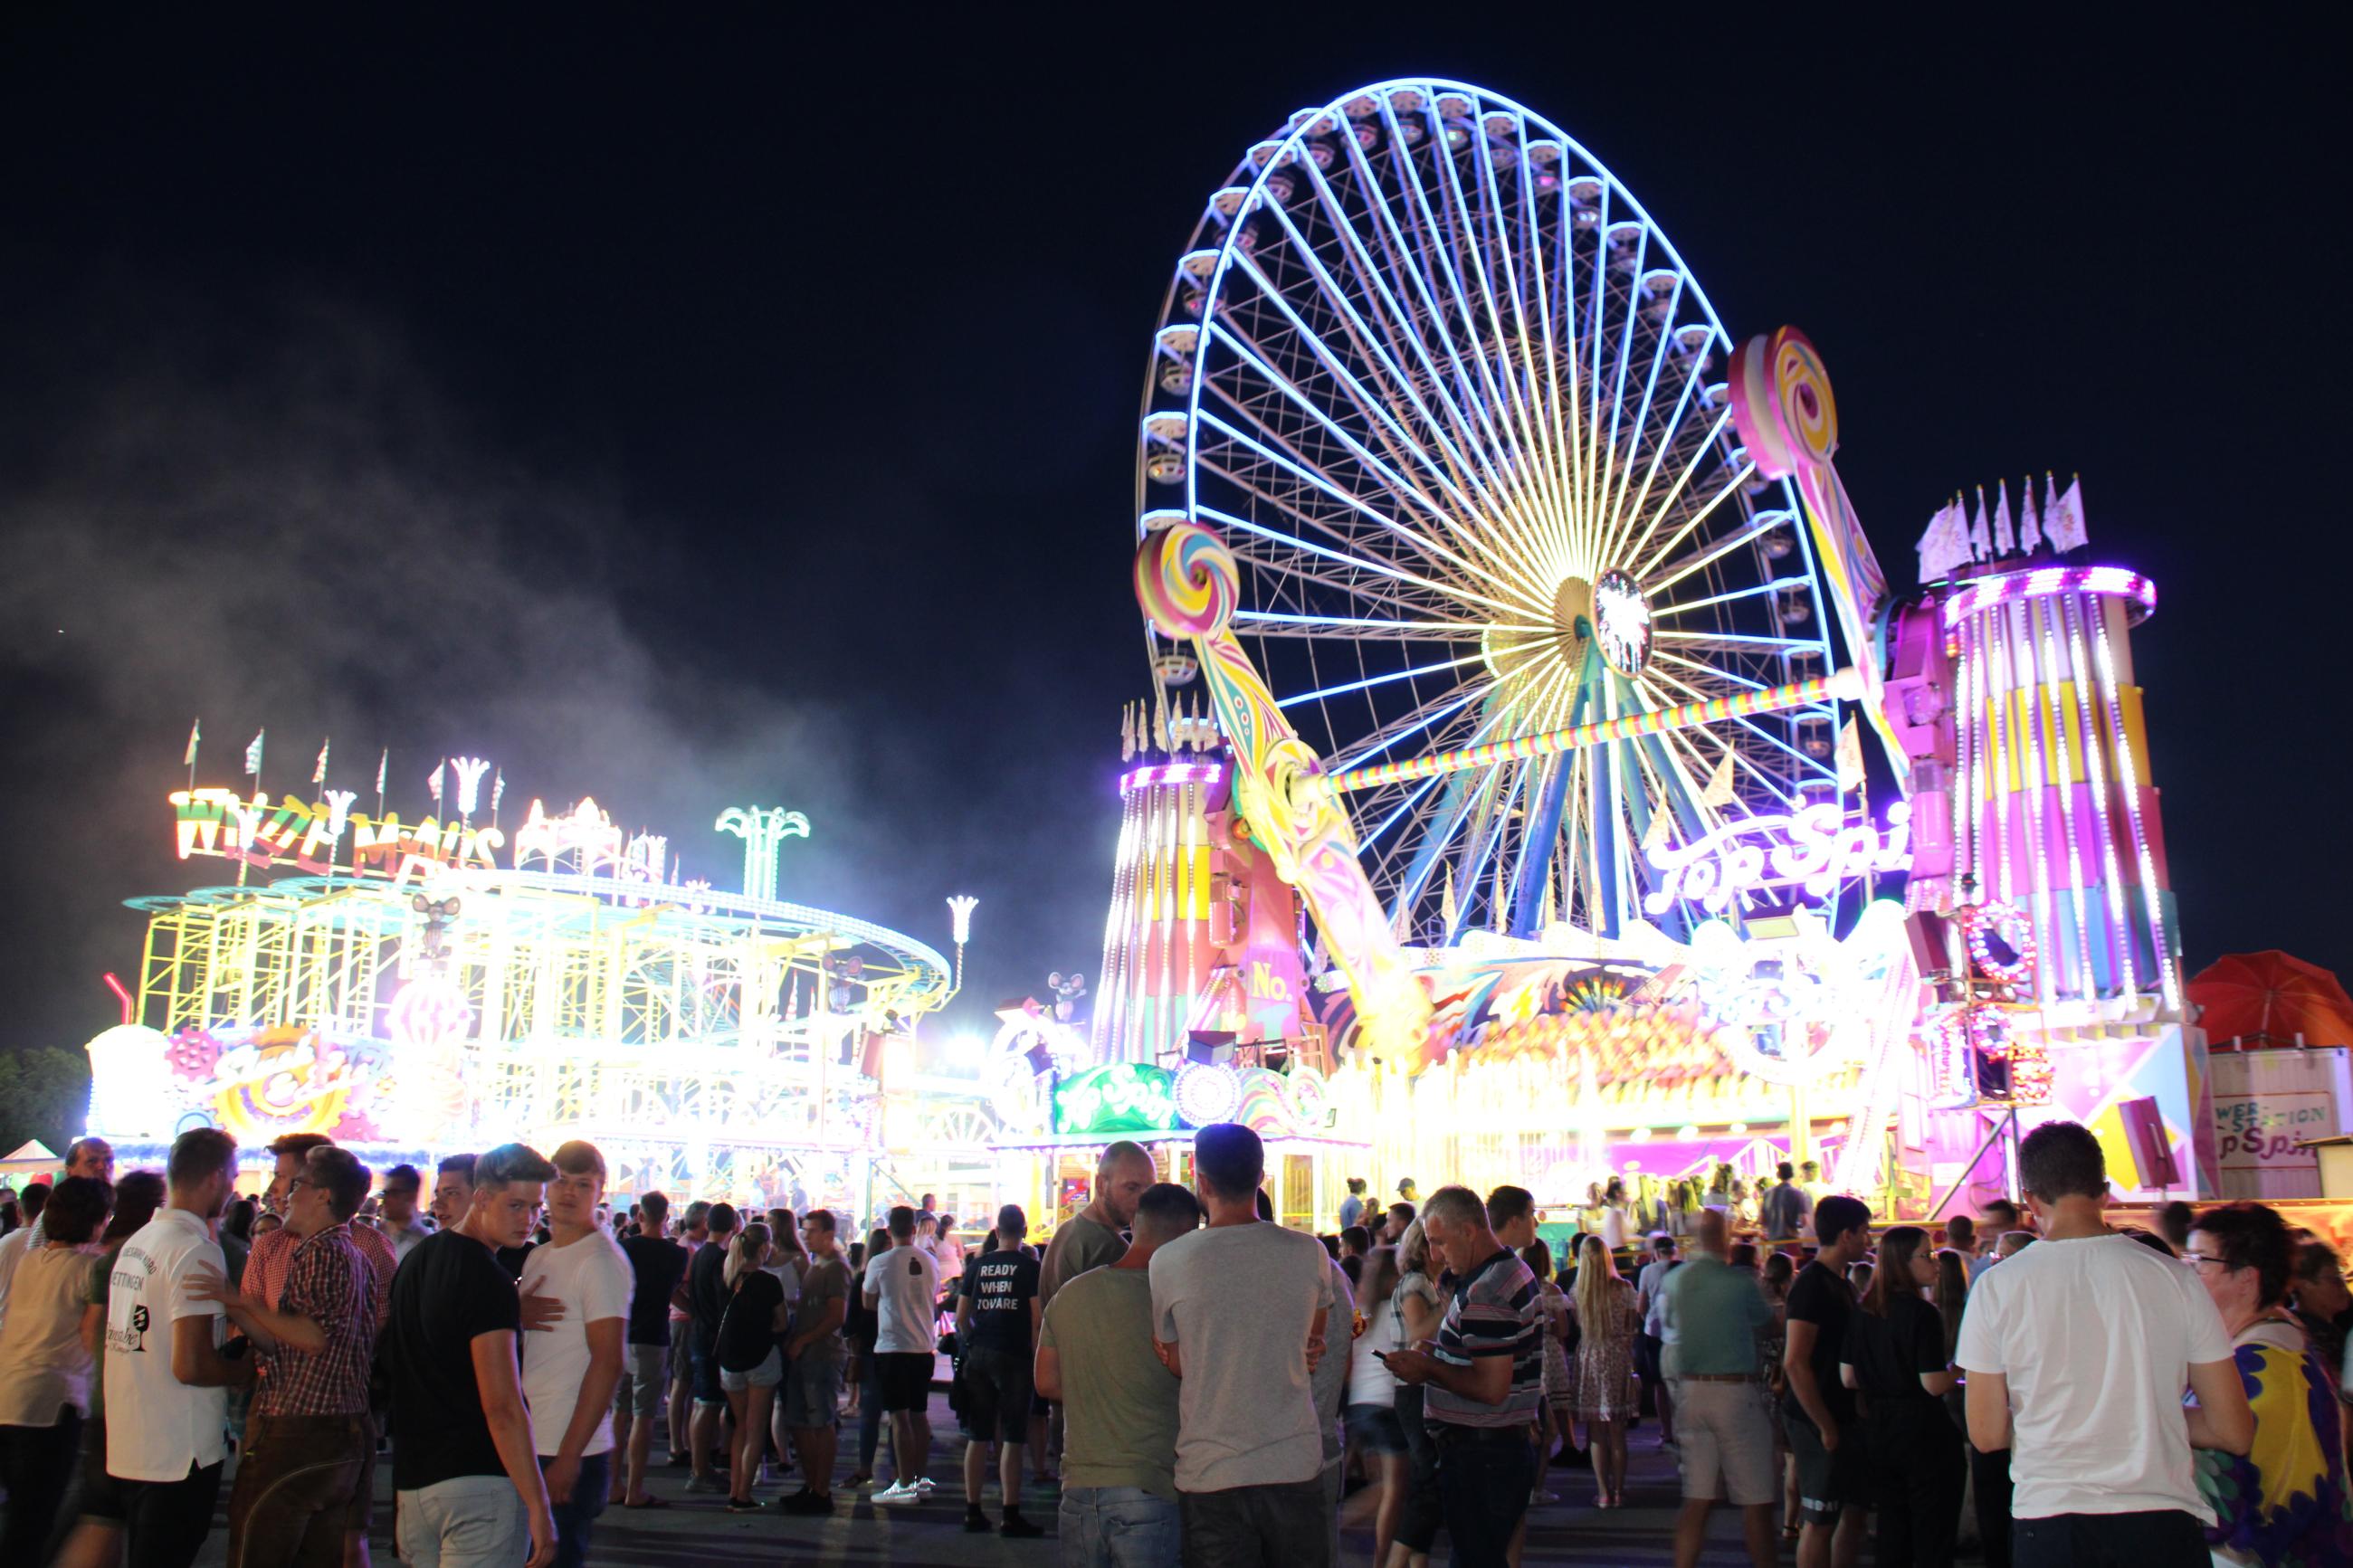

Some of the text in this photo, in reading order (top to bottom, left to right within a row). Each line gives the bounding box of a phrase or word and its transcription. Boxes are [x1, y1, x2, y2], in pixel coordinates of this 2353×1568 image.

[1643, 803, 1915, 916] Top Spi
[1252, 960, 1292, 1003] No.
[980, 1264, 1018, 1278] READY
[980, 1281, 1013, 1293] WHEN
